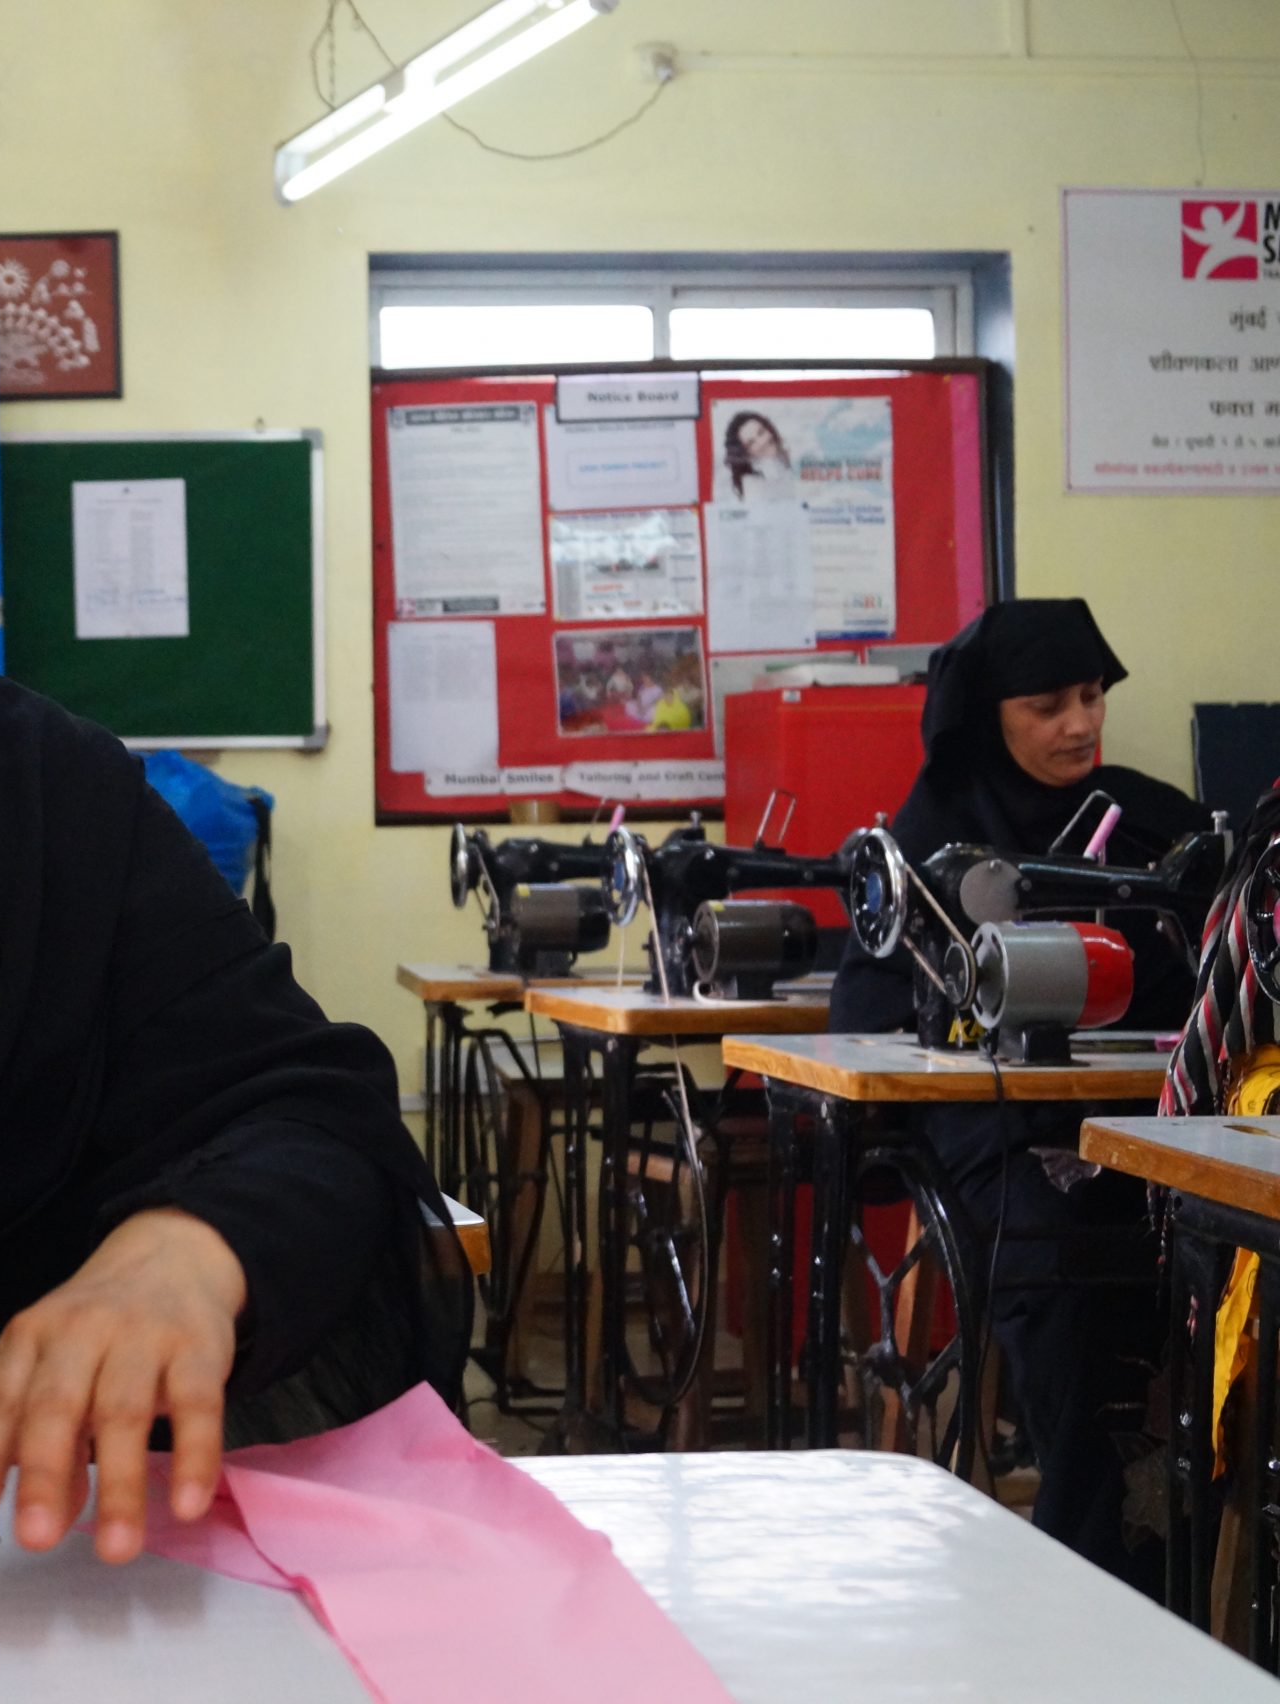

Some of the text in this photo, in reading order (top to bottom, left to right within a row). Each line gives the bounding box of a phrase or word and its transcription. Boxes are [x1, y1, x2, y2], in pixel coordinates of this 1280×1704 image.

[587, 389, 680, 403] Notice Board
[506, 771, 554, 783] Smiles
[579, 772, 632, 784] Tailoring
[638, 773, 661, 782] and
[665, 769, 694, 782] Craft
